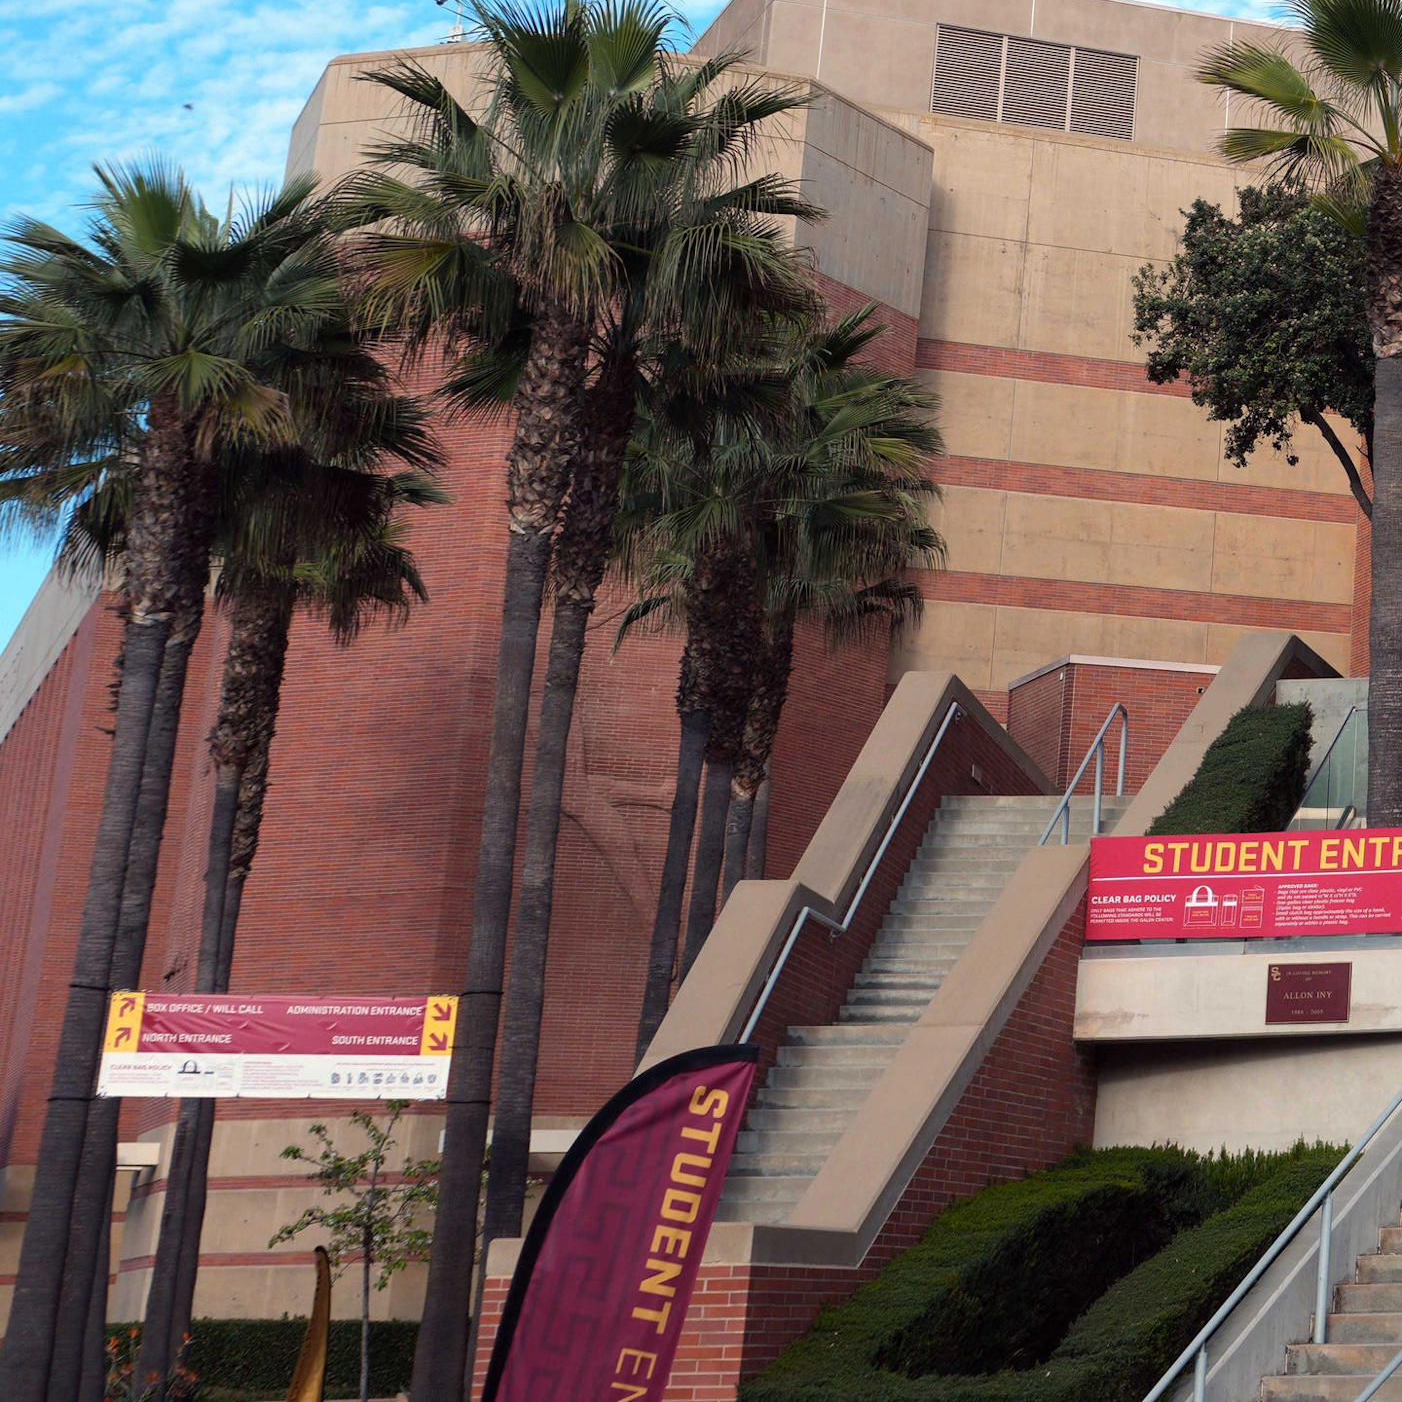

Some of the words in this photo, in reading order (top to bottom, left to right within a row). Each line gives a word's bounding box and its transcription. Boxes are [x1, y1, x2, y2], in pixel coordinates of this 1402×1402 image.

[1143, 839, 1310, 874] STUDENT
[1091, 896, 1122, 904] CLEAR
[1123, 895, 1142, 904] BAG
[1144, 895, 1177, 903] POLICY
[1283, 991, 1314, 999] ALLON
[146, 1003, 168, 1013] BOX
[169, 1004, 204, 1013] OFFICE
[204, 1004, 212, 1014] /
[212, 1004, 237, 1014] WILL
[238, 1004, 264, 1014] CALL
[286, 1006, 370, 1015] ADMINISTRATION
[370, 1006, 424, 1016] ENTRANCE
[142, 1032, 178, 1043] NORTH
[178, 1033, 233, 1044] ENTRANCE
[331, 1036, 366, 1045] SOUTH
[366, 1036, 419, 1046] ENTRANCE
[630, 1085, 730, 1335] STUDENT
